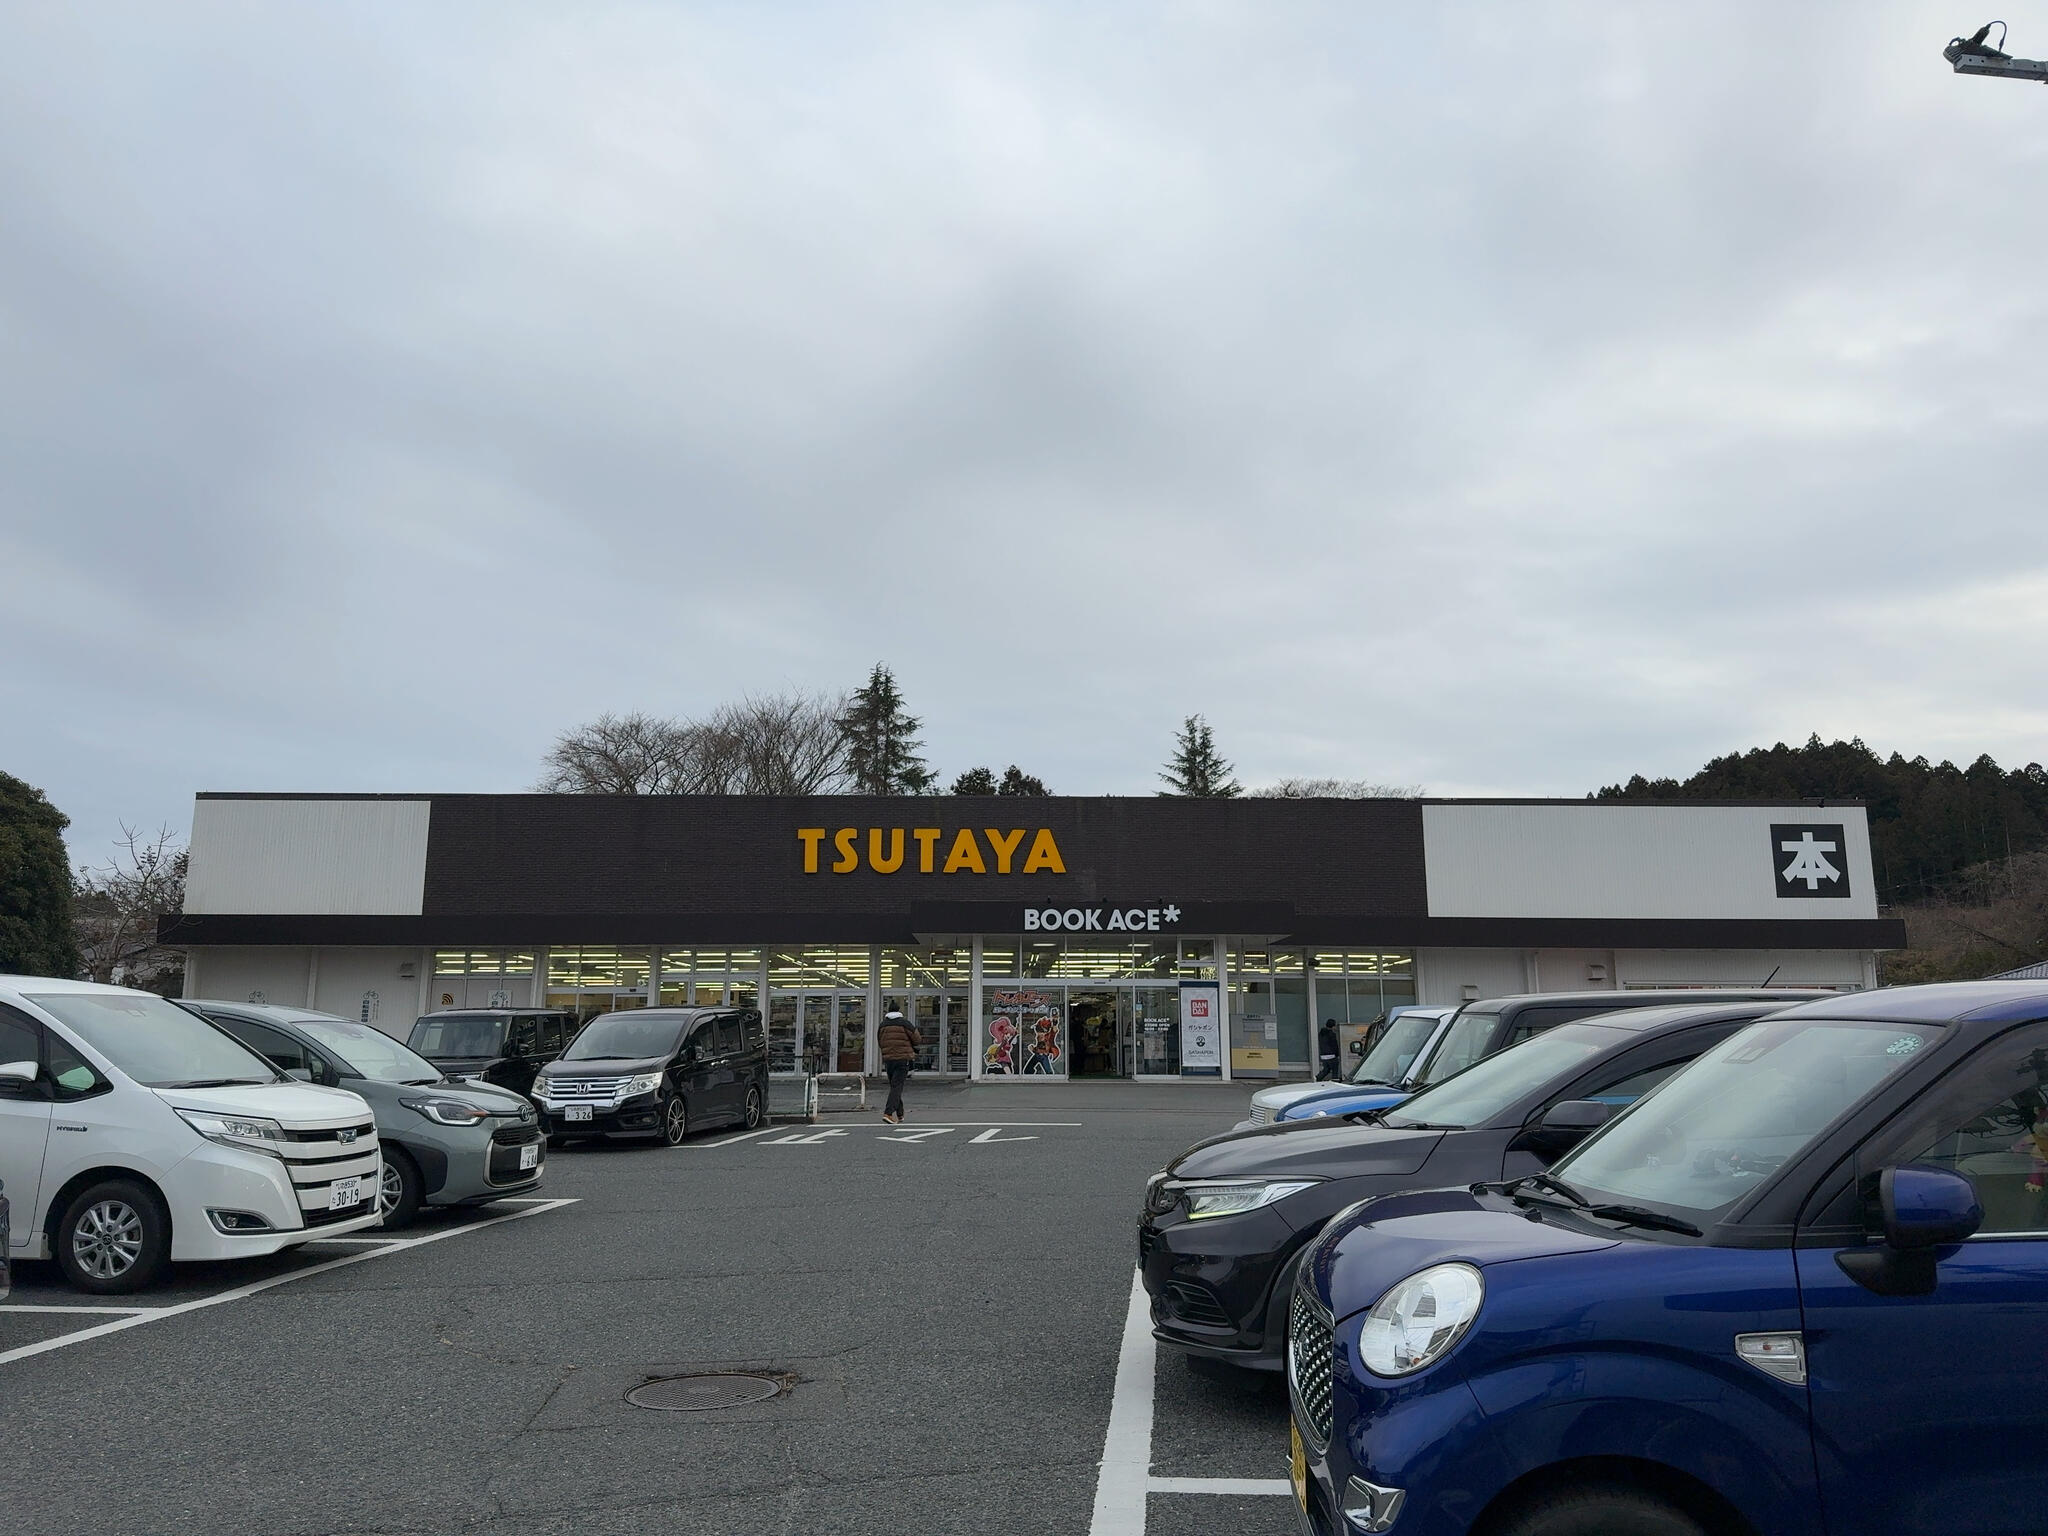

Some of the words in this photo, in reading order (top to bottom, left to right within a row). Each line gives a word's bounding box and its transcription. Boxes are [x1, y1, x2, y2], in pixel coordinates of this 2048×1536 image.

[798, 828, 1067, 874] TSUTAYA
[1781, 832, 1841, 890] 本
[1024, 908, 1103, 931] BOOK
[1192, 1001, 1207, 1009] BAN
